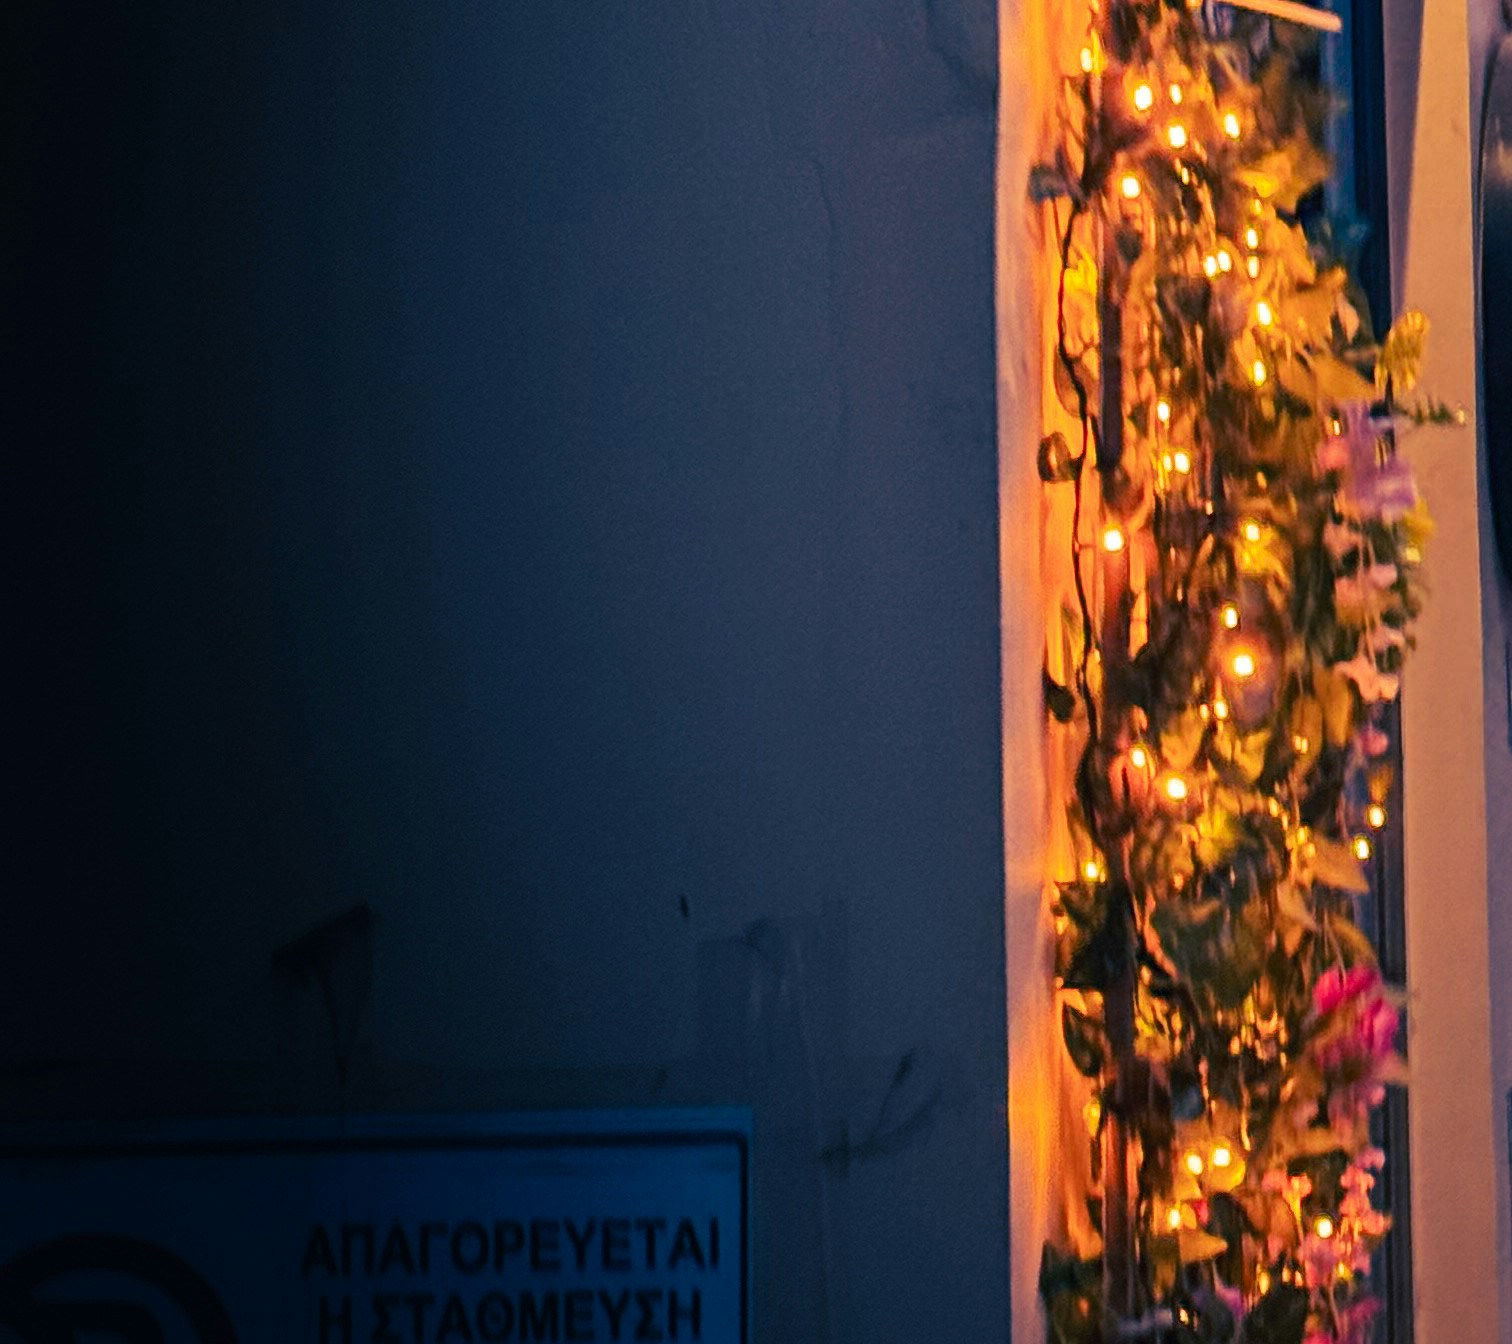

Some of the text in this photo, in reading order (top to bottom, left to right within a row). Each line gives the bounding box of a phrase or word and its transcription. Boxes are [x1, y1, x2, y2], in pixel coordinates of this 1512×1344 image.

[303, 1217, 720, 1277] ΑΠΑΓΟΡΕΥΕΤΑΙ
[319, 1290, 701, 1344] Η ΣΤΑΘΜΕΥΣΗ
